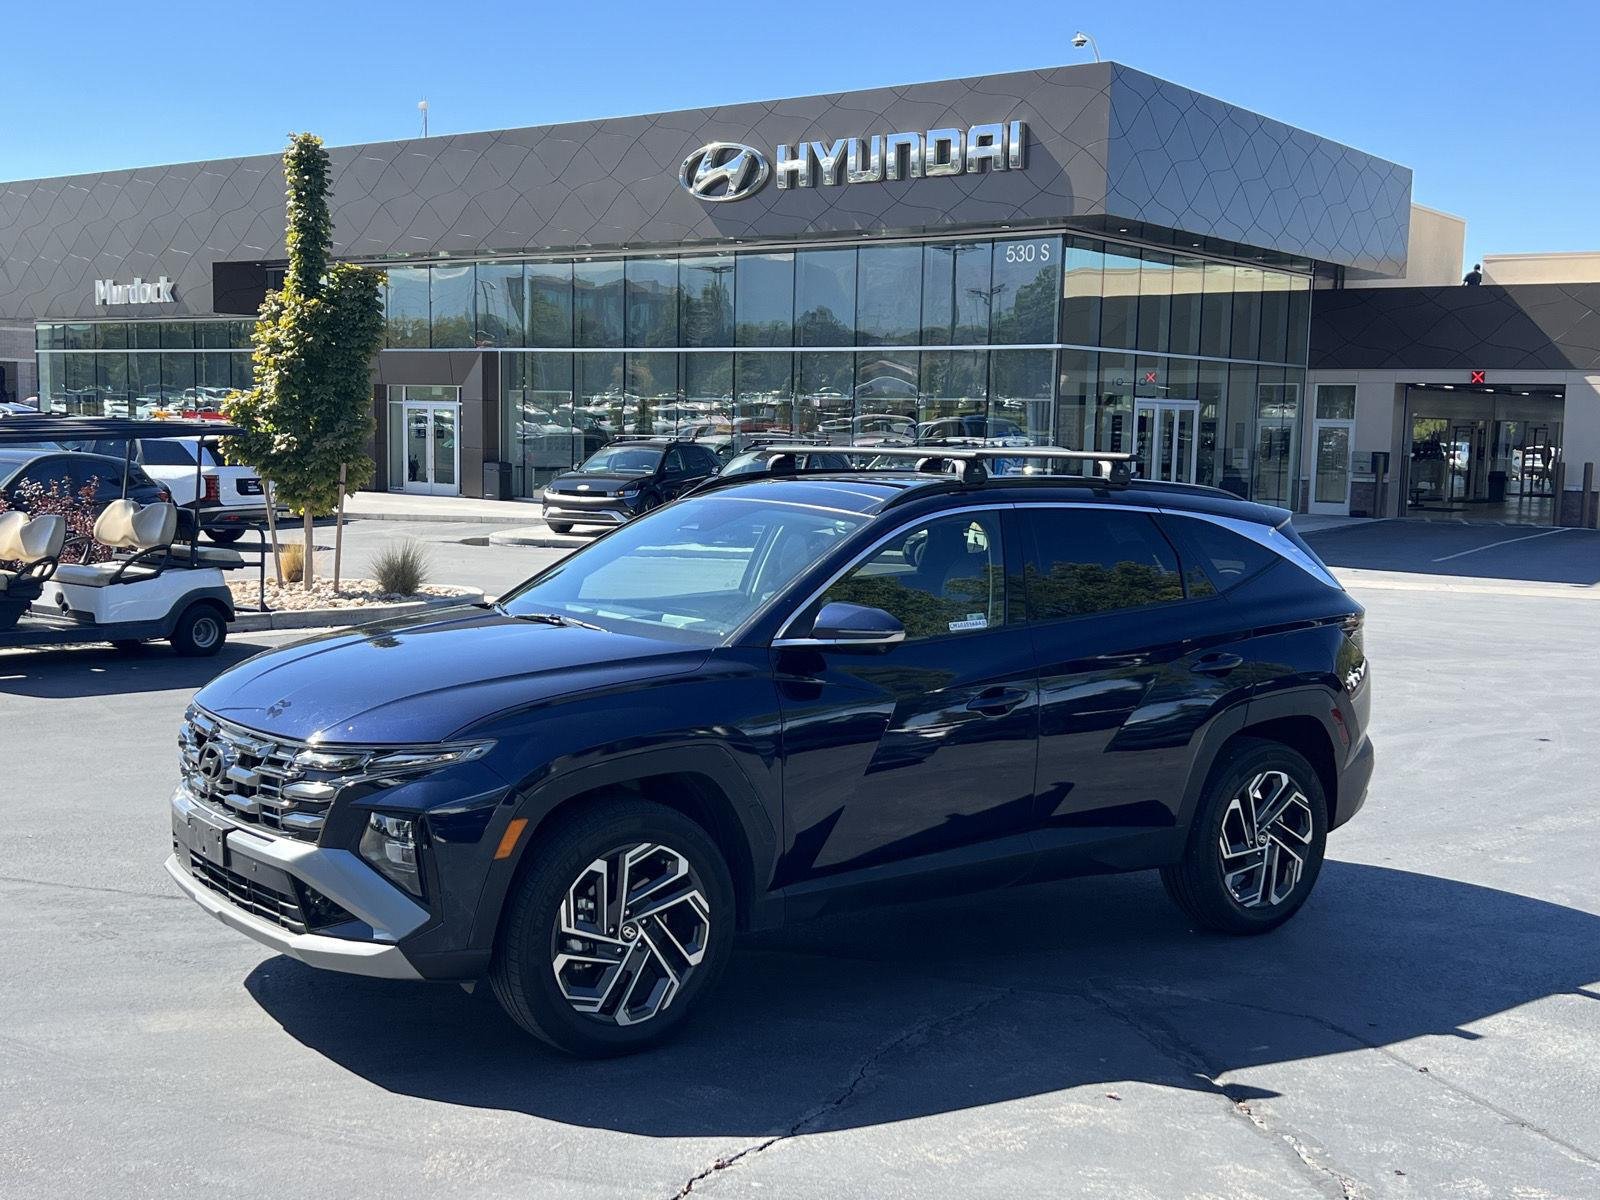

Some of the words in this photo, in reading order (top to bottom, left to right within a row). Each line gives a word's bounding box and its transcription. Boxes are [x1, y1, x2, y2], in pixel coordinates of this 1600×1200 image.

[776, 120, 1026, 189] HYUNDAI
[1006, 244, 1035, 262] 530
[1040, 243, 1050, 261] S
[95, 276, 174, 305] Murdock
